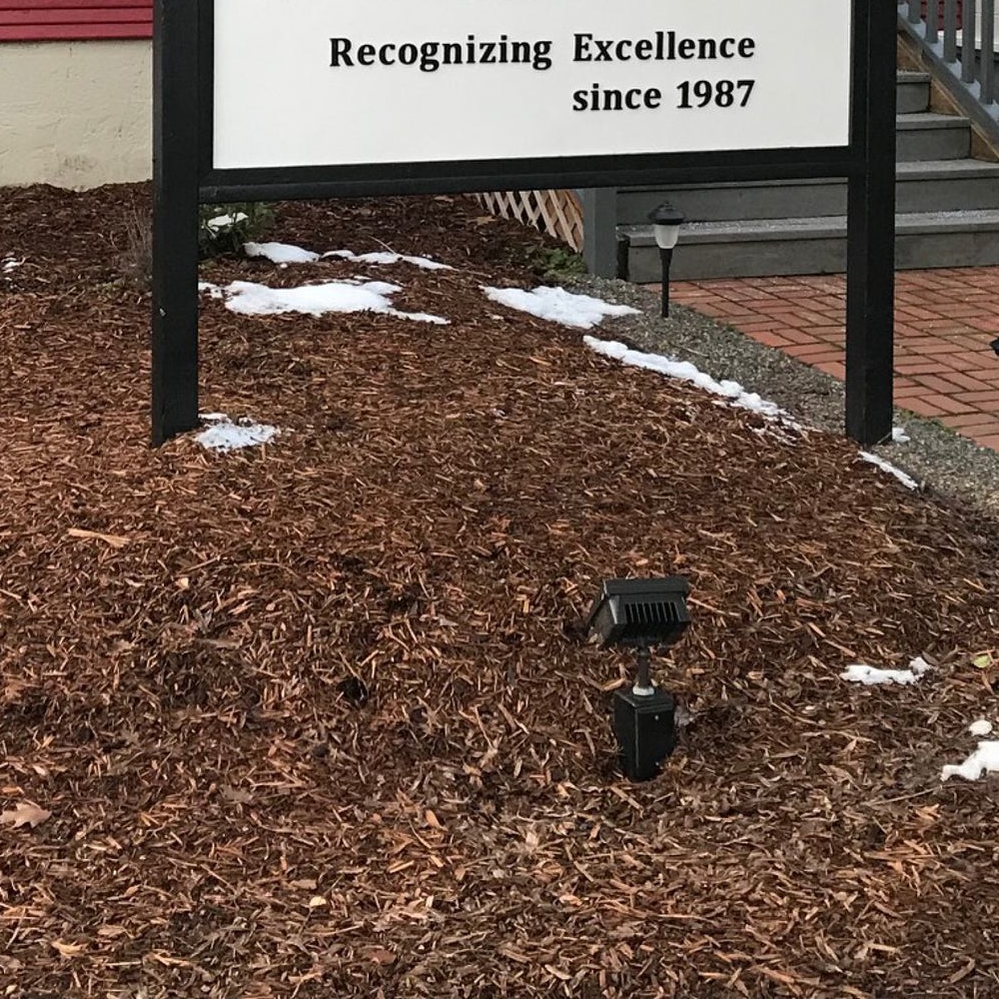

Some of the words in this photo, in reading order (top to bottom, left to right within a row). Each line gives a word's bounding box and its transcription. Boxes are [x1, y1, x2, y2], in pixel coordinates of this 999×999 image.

[330, 35, 552, 71] Recognizing
[573, 31, 755, 61] Excellence
[573, 83, 661, 111] since
[677, 80, 755, 108] 1987
